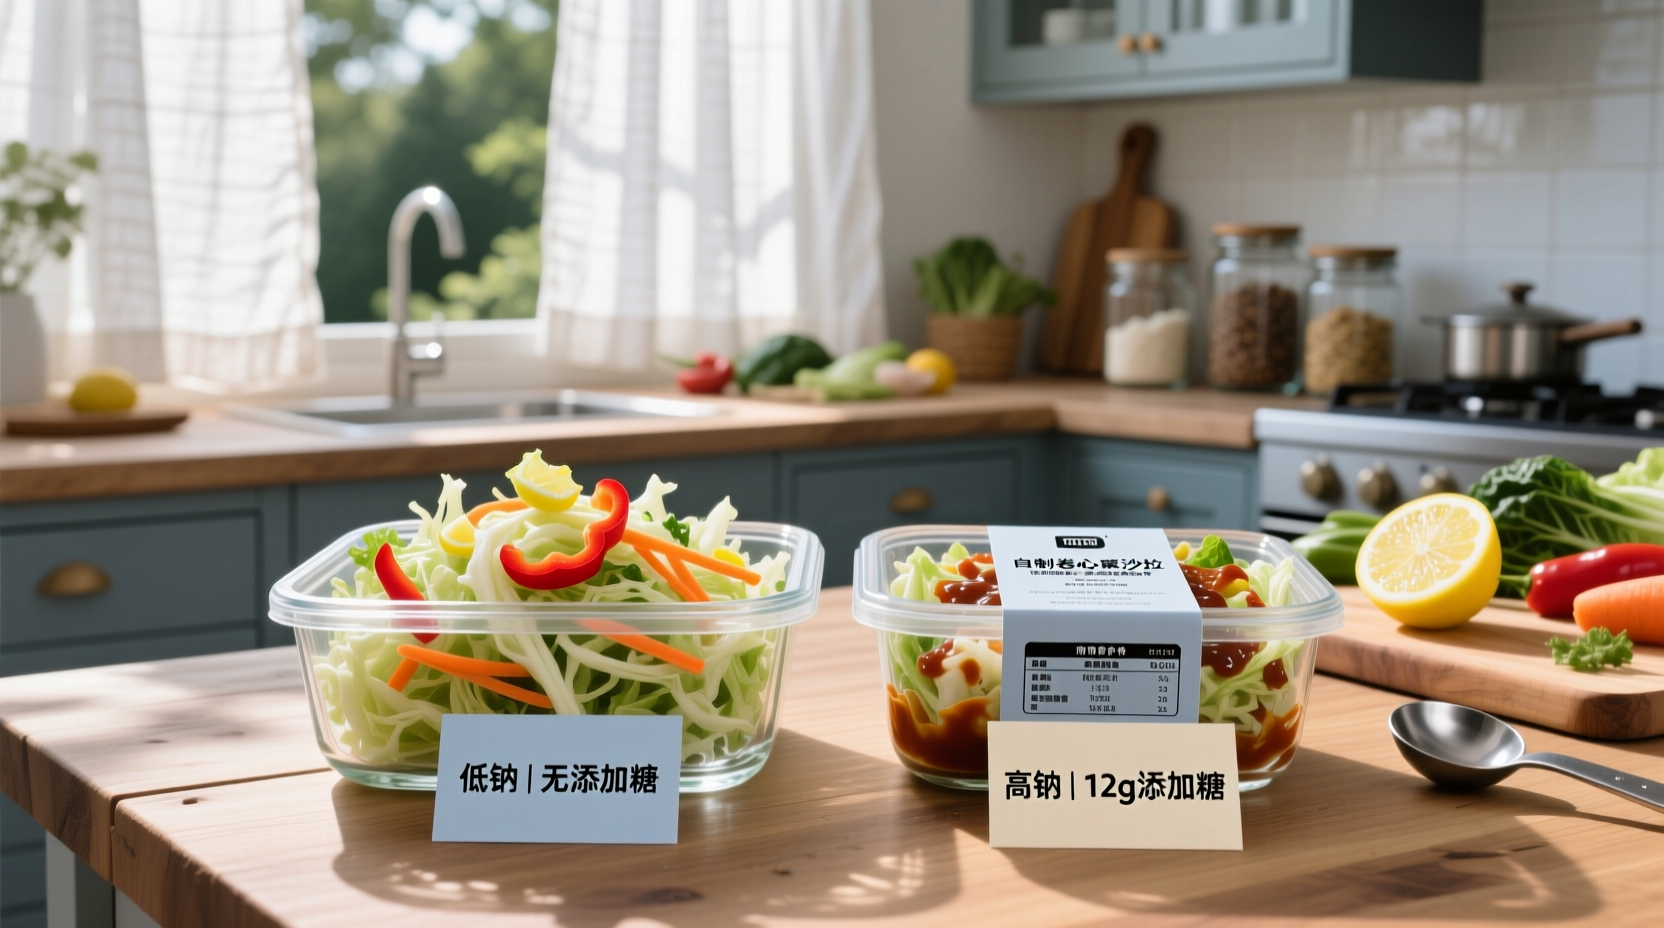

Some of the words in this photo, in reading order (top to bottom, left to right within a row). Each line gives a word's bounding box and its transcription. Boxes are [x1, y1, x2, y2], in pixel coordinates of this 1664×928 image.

[459, 762, 518, 794] 低钠
[540, 763, 660, 794] 无添加糖
[1004, 769, 1061, 801] 高钠
[1084, 770, 1226, 806] 12g添加糖
